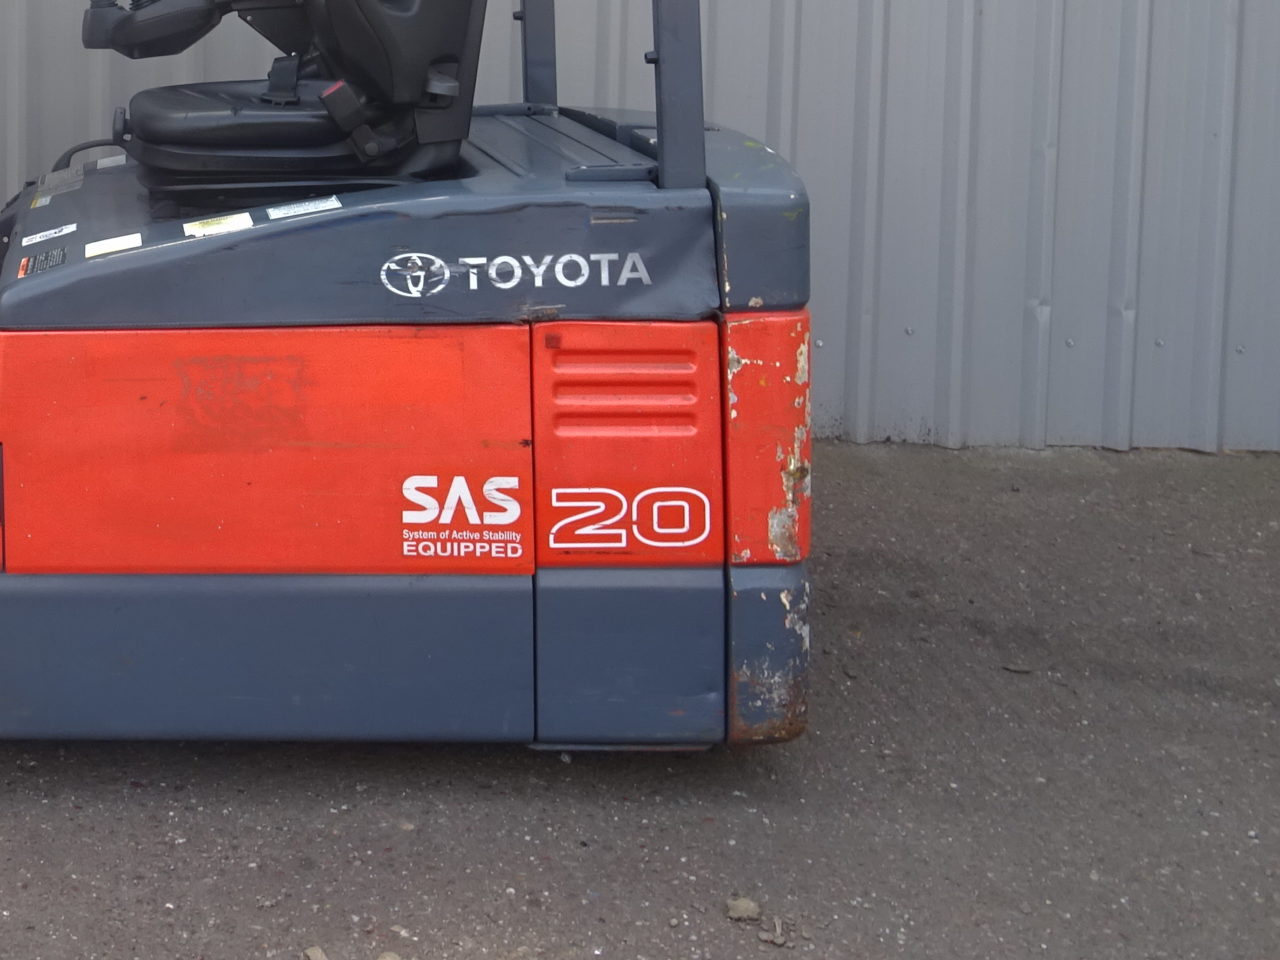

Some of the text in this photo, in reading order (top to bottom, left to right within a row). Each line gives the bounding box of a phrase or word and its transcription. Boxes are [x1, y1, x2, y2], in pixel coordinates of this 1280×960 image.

[458, 252, 653, 290] TOYOTA
[402, 475, 521, 525] SAS
[549, 486, 711, 548] 20
[402, 529, 521, 542] System of Active Stability
[402, 541, 523, 558] EQUIPPED
